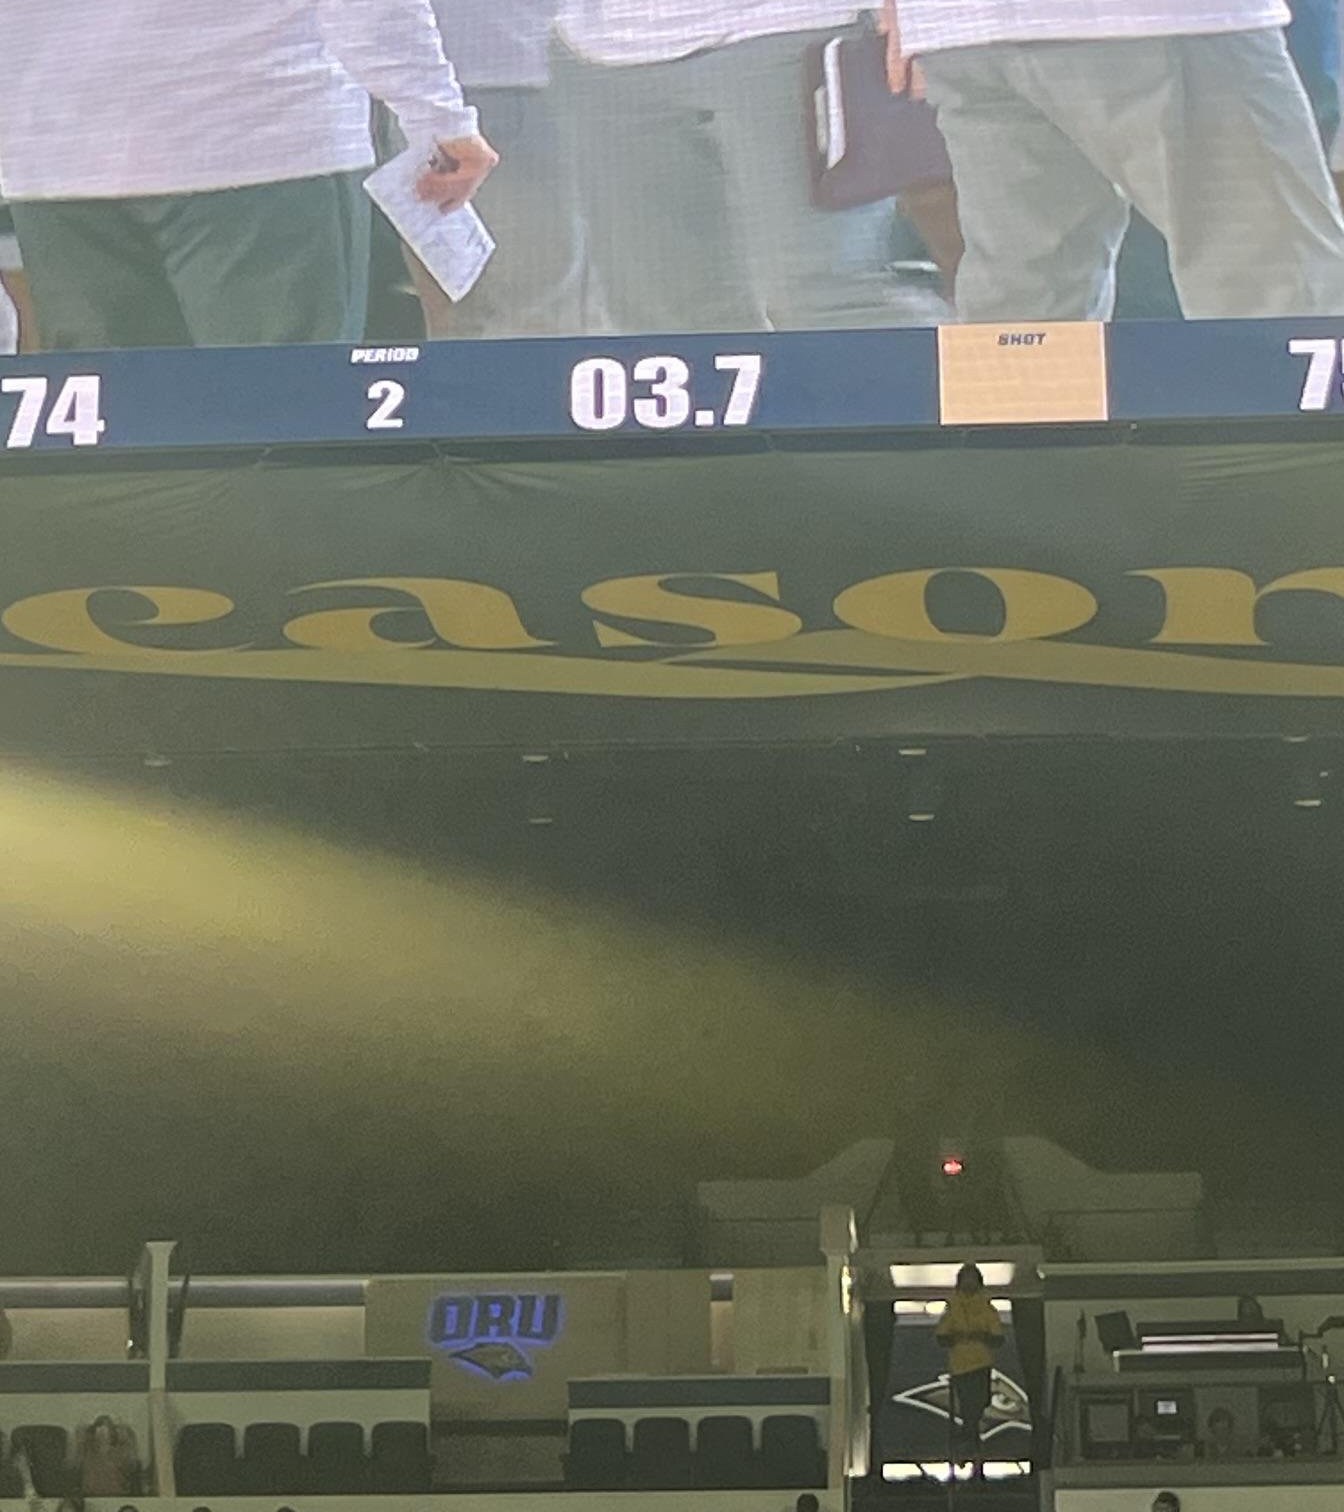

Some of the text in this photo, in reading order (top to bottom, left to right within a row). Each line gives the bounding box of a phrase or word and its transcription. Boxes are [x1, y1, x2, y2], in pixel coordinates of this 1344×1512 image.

[998, 331, 1046, 346] SHOT
[351, 346, 419, 365] PERIOD
[0, 374, 104, 447] 74
[365, 379, 404, 431] 2
[570, 354, 761, 429] 03.7
[431, 1295, 559, 1342] ORU
